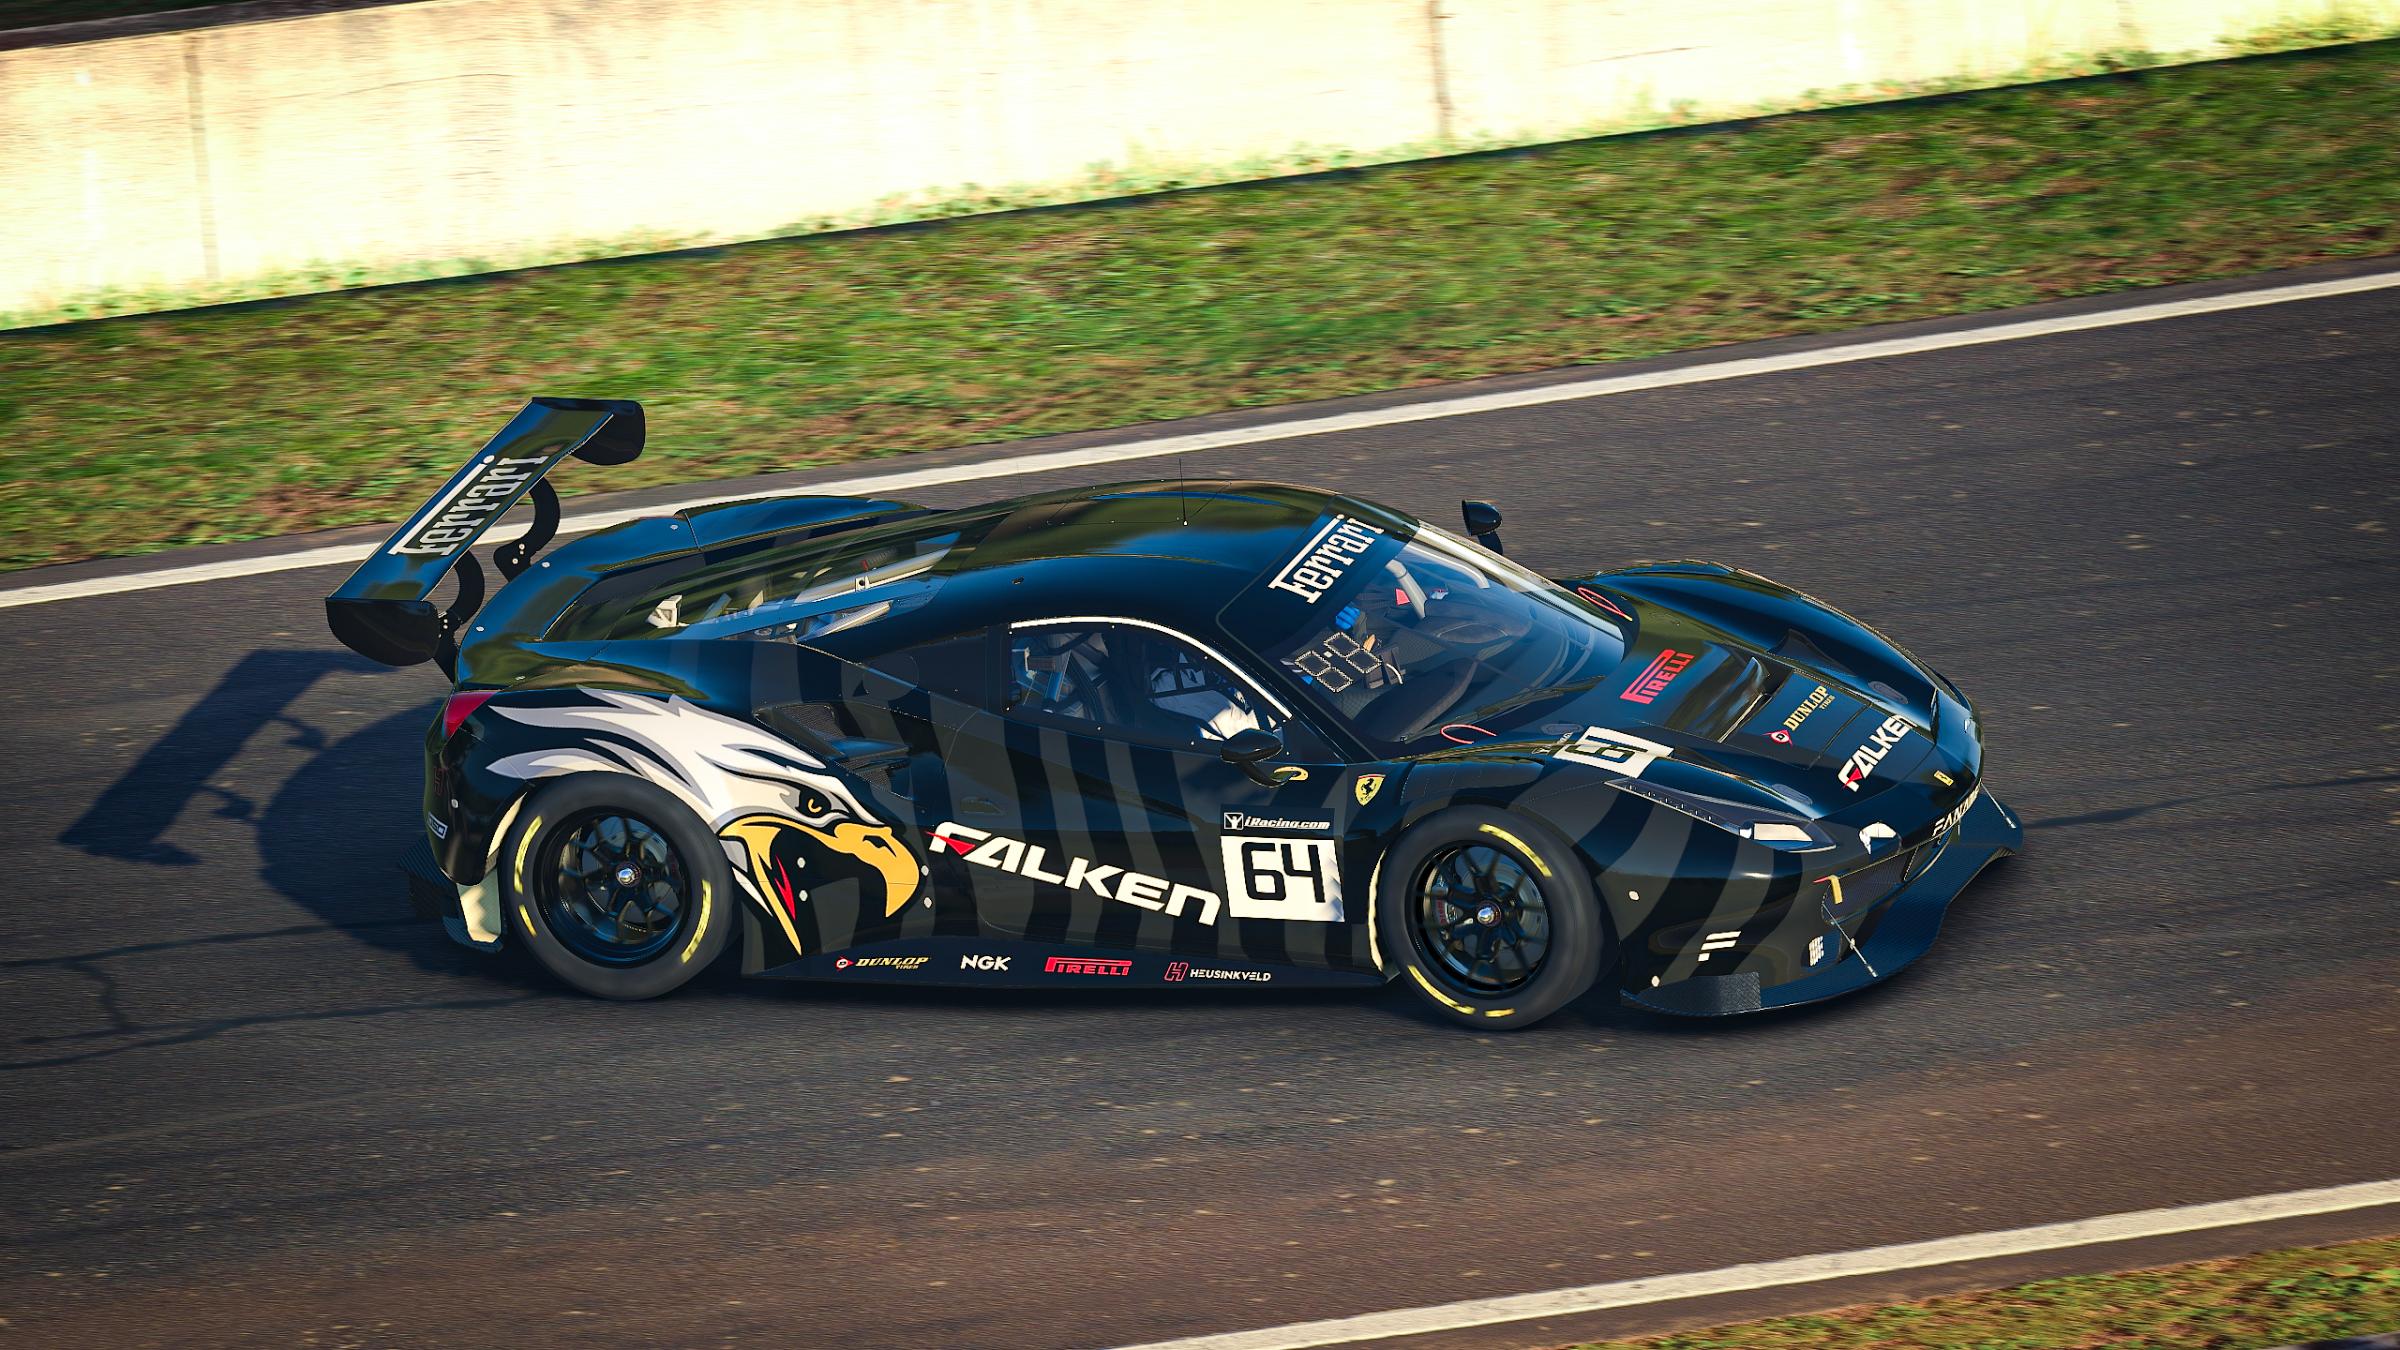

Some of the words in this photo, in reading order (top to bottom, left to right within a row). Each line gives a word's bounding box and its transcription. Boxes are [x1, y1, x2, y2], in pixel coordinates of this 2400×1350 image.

[387, 455, 549, 556] Ferrari
[1268, 514, 1384, 604] Ferrari
[1620, 649, 1695, 704] PIRELLI
[1783, 685, 1829, 732] DUNLOP
[1244, 816, 1330, 830] iRacing.com
[926, 821, 1221, 927] FALKEN
[1241, 842, 1326, 903] 64
[856, 957, 930, 967] DUNLOP
[960, 955, 1011, 971] NGK
[1044, 957, 1132, 976] PIRELLI
[1190, 968, 1272, 982] HEUSINKVELD
